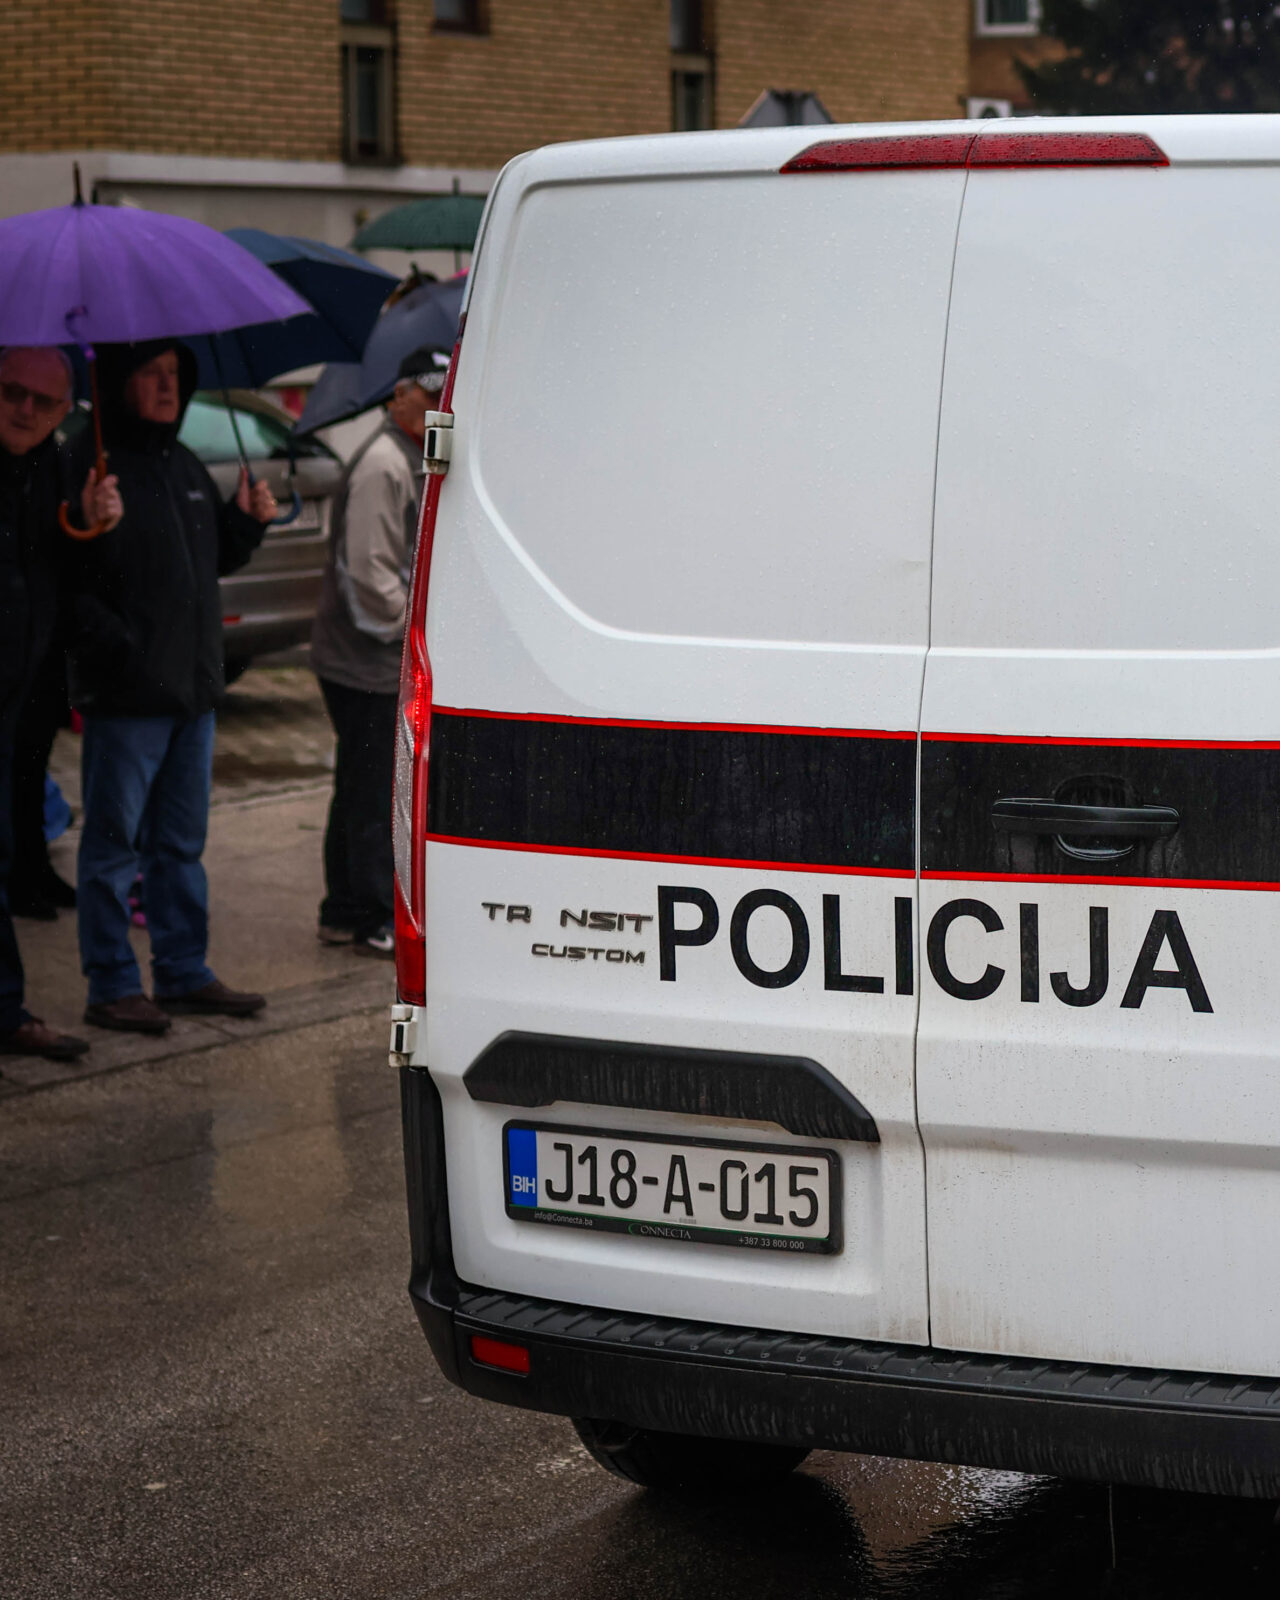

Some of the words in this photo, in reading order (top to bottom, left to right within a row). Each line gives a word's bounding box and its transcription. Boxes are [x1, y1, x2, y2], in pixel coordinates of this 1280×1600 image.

[531, 943, 646, 964] CUSTOM
[657, 884, 1215, 1014] POLICIJA
[512, 1175, 537, 1195] BIH
[545, 1142, 820, 1228] J18-A-015
[534, 1211, 594, 1228] info@Connecta.ba
[738, 1236, 759, 1246] +387
[760, 1238, 771, 1248] 33
[771, 1240, 788, 1249] 800
[789, 1241, 805, 1250] 000
